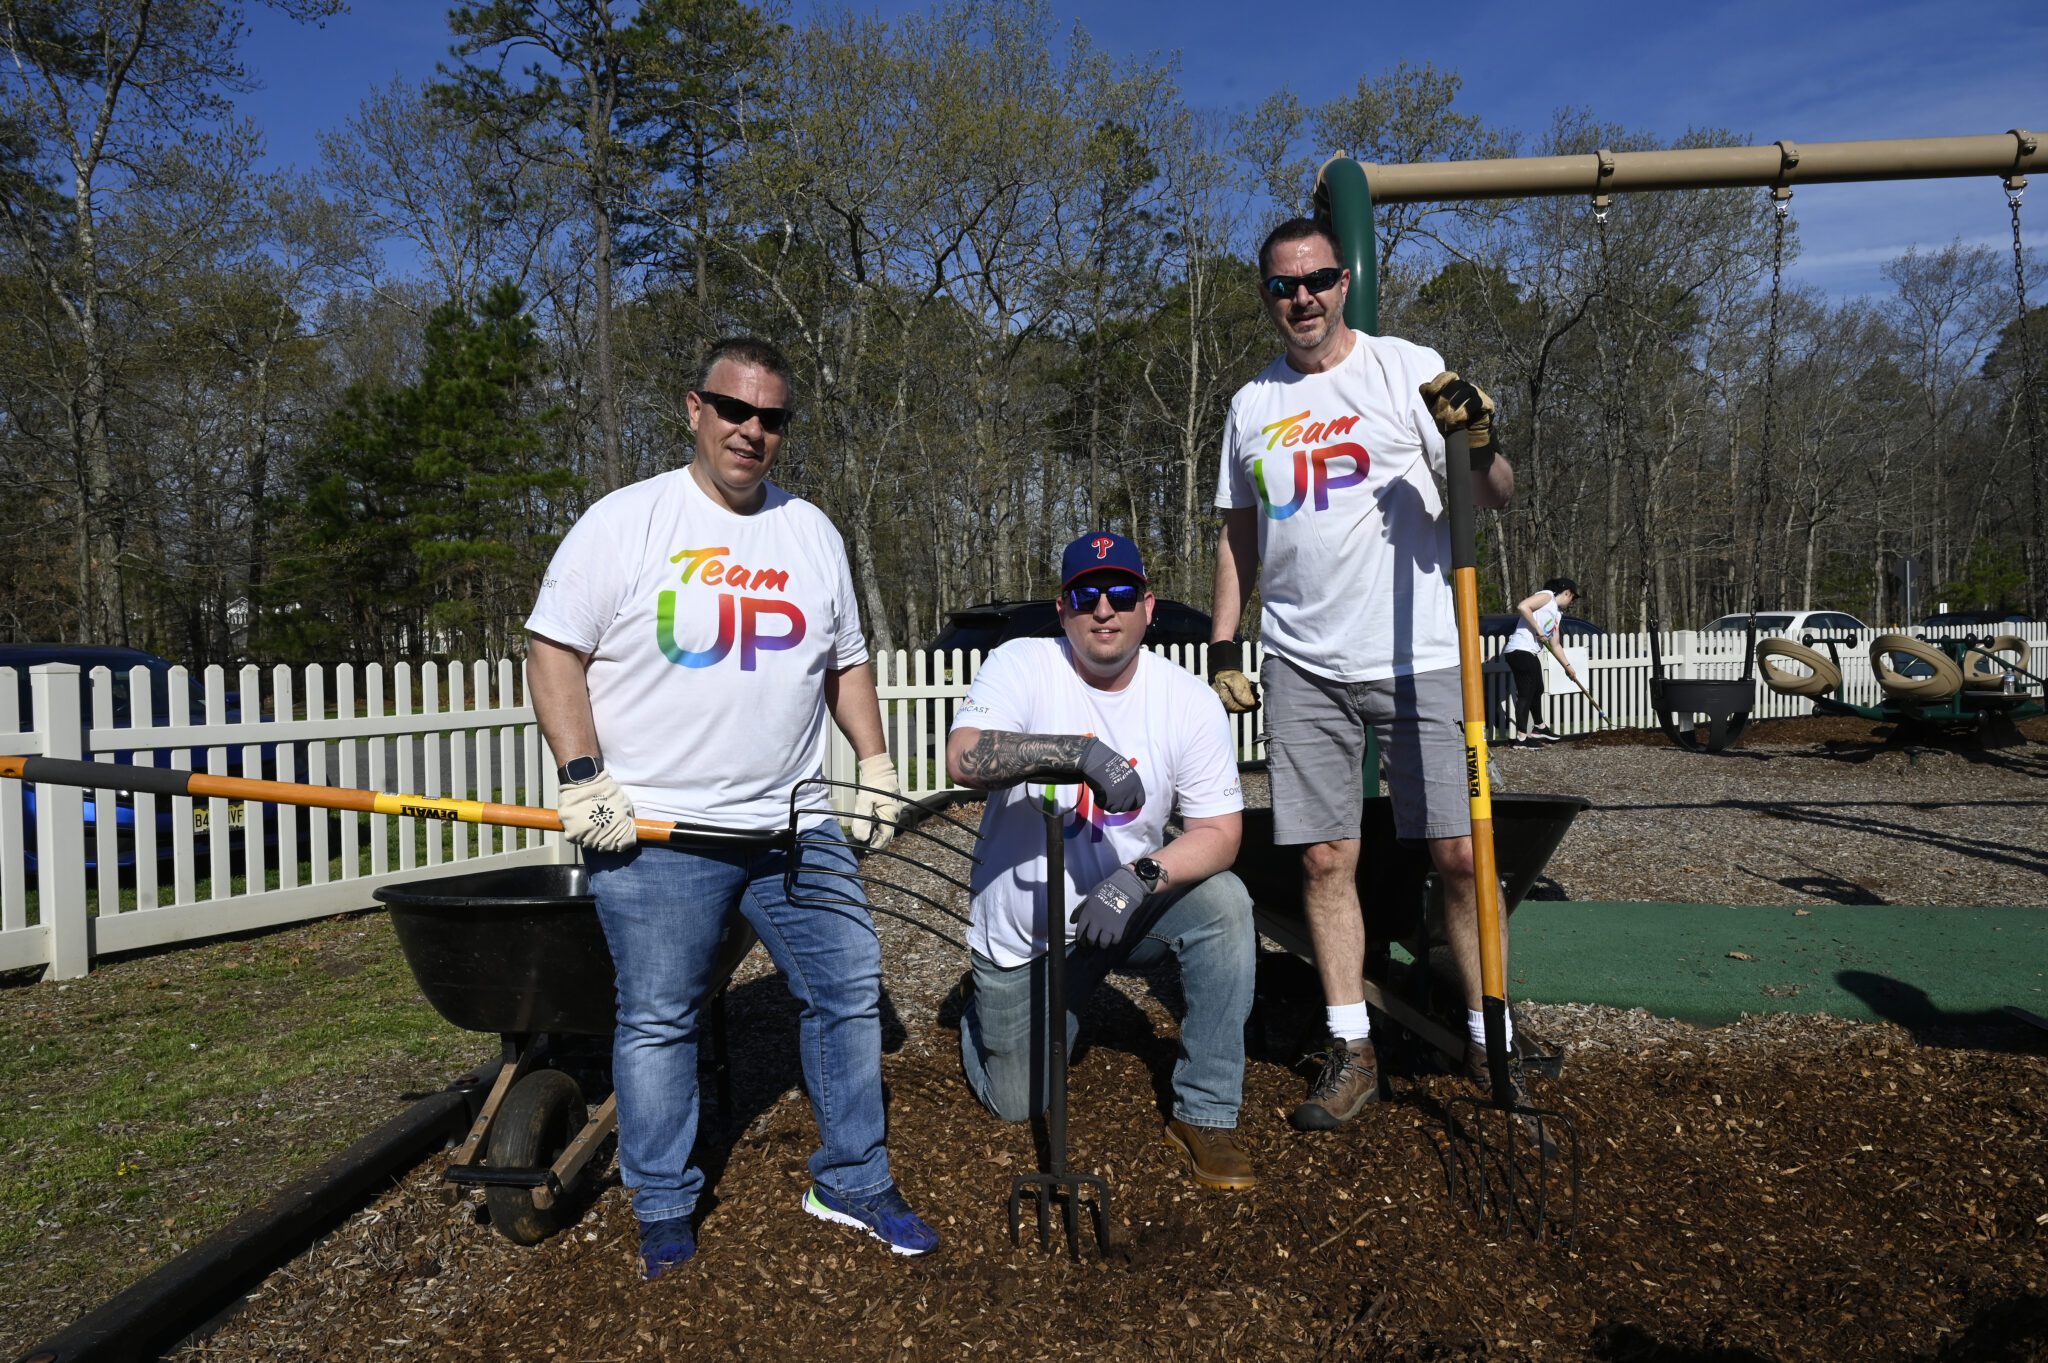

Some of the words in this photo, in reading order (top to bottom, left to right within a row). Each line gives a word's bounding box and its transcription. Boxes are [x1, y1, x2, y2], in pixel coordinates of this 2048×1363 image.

[1261, 409, 1361, 451] Team
[1253, 442, 1371, 521] UP
[669, 546, 790, 592] Team
[1091, 537, 1114, 559] P
[656, 590, 807, 672] UP
